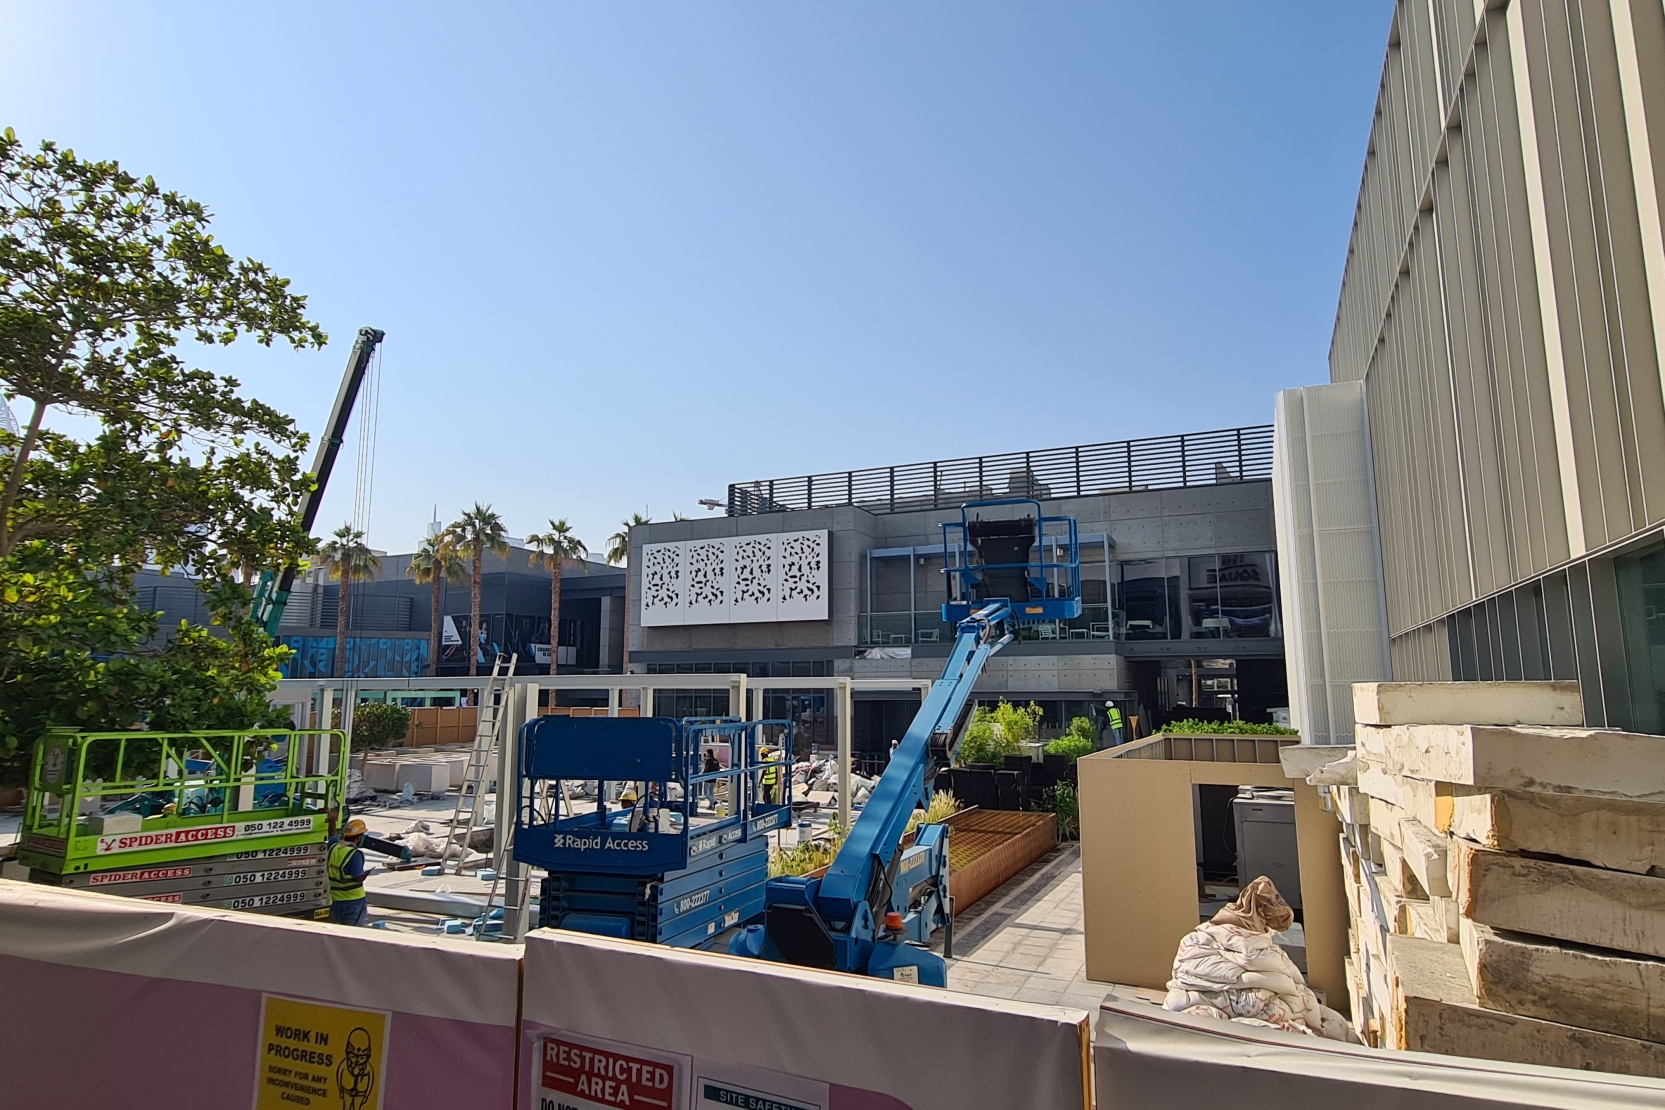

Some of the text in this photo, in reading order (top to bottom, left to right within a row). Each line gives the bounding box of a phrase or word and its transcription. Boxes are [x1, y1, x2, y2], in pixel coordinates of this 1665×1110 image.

[118, 833, 174, 849] SPIDER
[176, 826, 235, 842] ACCESS
[244, 823, 263, 832] 050
[267, 821, 285, 829] 122
[287, 818, 311, 827] 4999
[565, 834, 649, 851] Rapid Access
[236, 846, 309, 860] 050 1224999
[91, 867, 191, 884] SPIDER ACCESS
[234, 869, 307, 885] 050 1224999
[232, 892, 306, 909] 050 1224999
[275, 1024, 329, 1046] WORK IN
[267, 1042, 333, 1067] PROGRESS
[546, 1042, 669, 1089] RESTRICTED
[268, 1065, 328, 1085] SORRY FOR ANY
[266, 1076, 328, 1098] INCONVENIENCE
[577, 1074, 631, 1105] AREA
[280, 1091, 311, 1106] CAUSED
[720, 1091, 745, 1106] SITE
